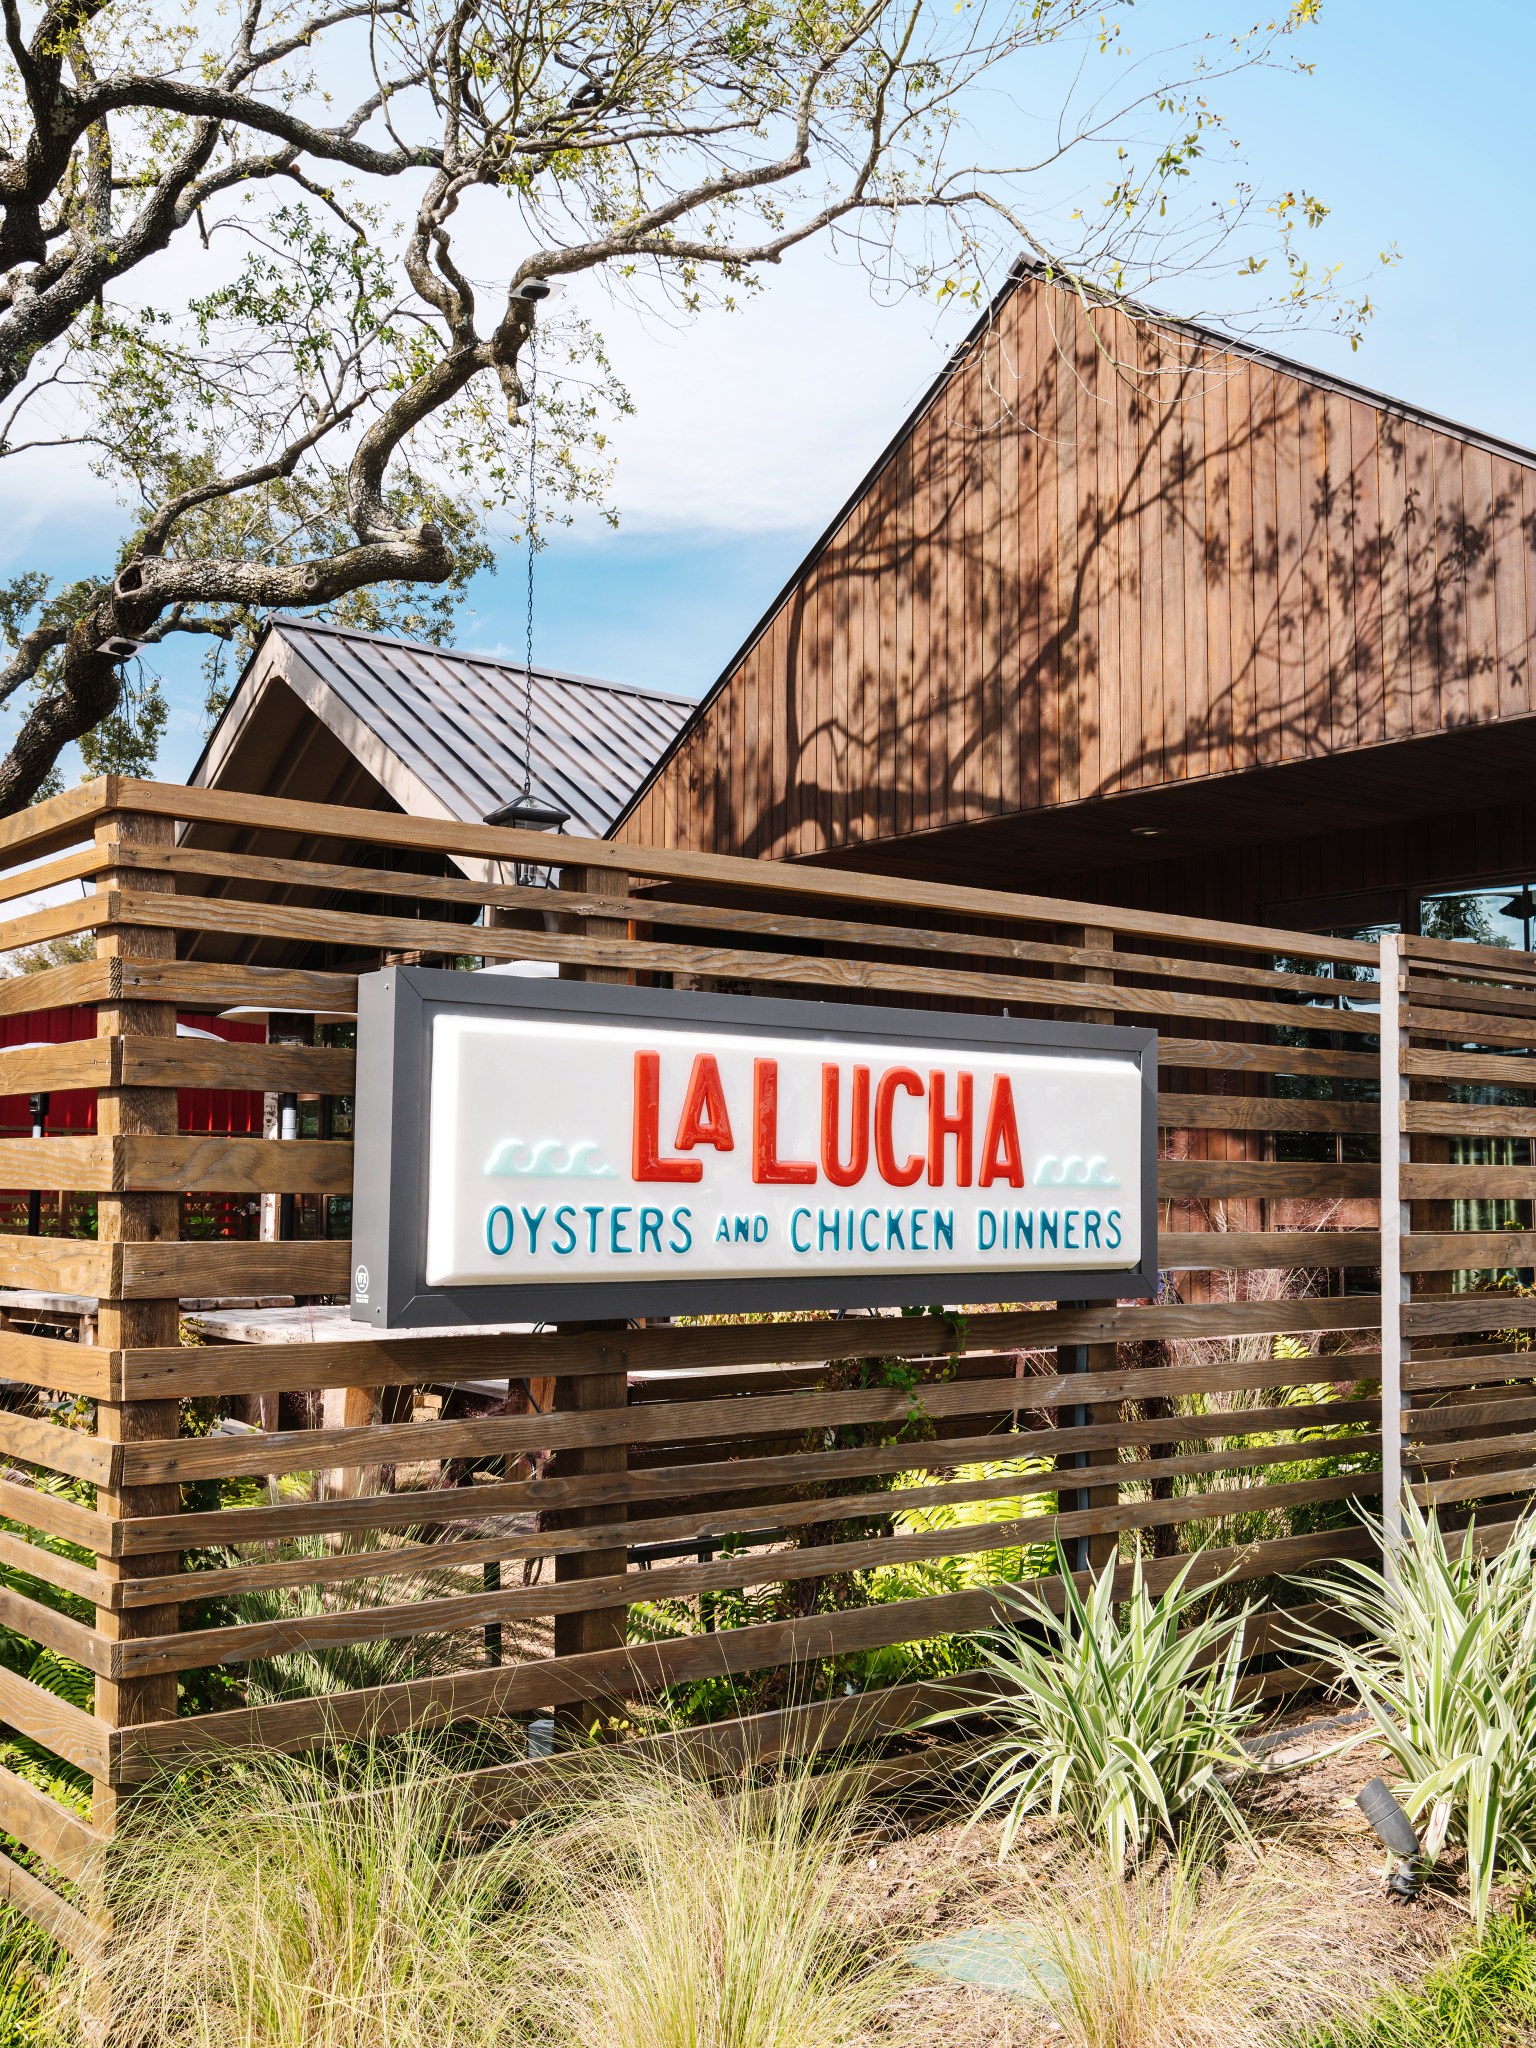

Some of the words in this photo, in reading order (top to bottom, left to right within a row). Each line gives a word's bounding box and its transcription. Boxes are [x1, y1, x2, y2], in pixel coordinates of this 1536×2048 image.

[630, 1050, 735, 1184] LA
[751, 1058, 1025, 1189] LUCHA
[486, 1204, 693, 1256] OYSTERS
[715, 1216, 769, 1244] AND
[790, 1207, 955, 1254] CHICKEN
[977, 1208, 1123, 1252] DINNERS
